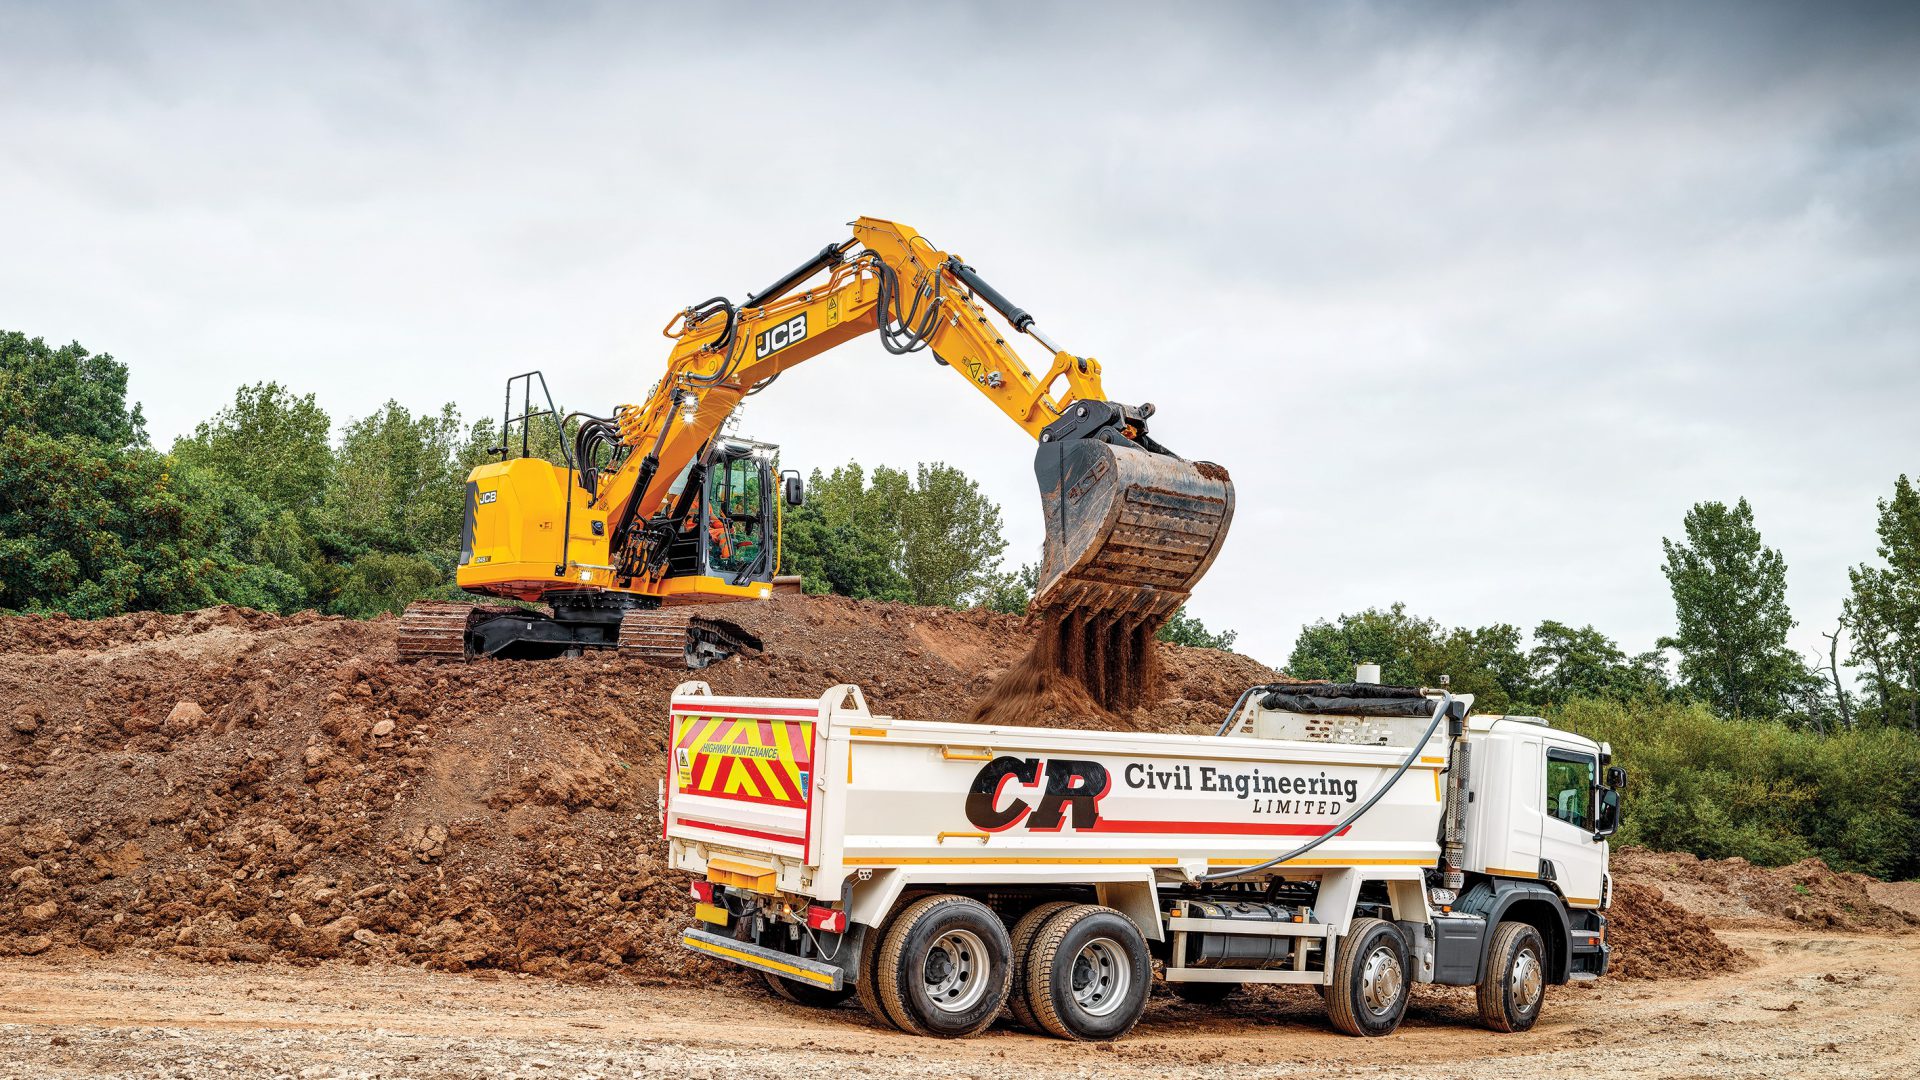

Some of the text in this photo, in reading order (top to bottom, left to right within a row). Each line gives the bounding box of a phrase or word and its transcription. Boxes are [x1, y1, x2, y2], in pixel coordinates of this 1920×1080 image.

[757, 315, 807, 358] JCB
[479, 491, 497, 504] JCB
[702, 743, 778, 759] HIGHWAY MAINTENANCE
[965, 756, 1112, 832] CR
[1124, 763, 1358, 803] Civil Engineering
[1252, 799, 1342, 815] LIMITED
